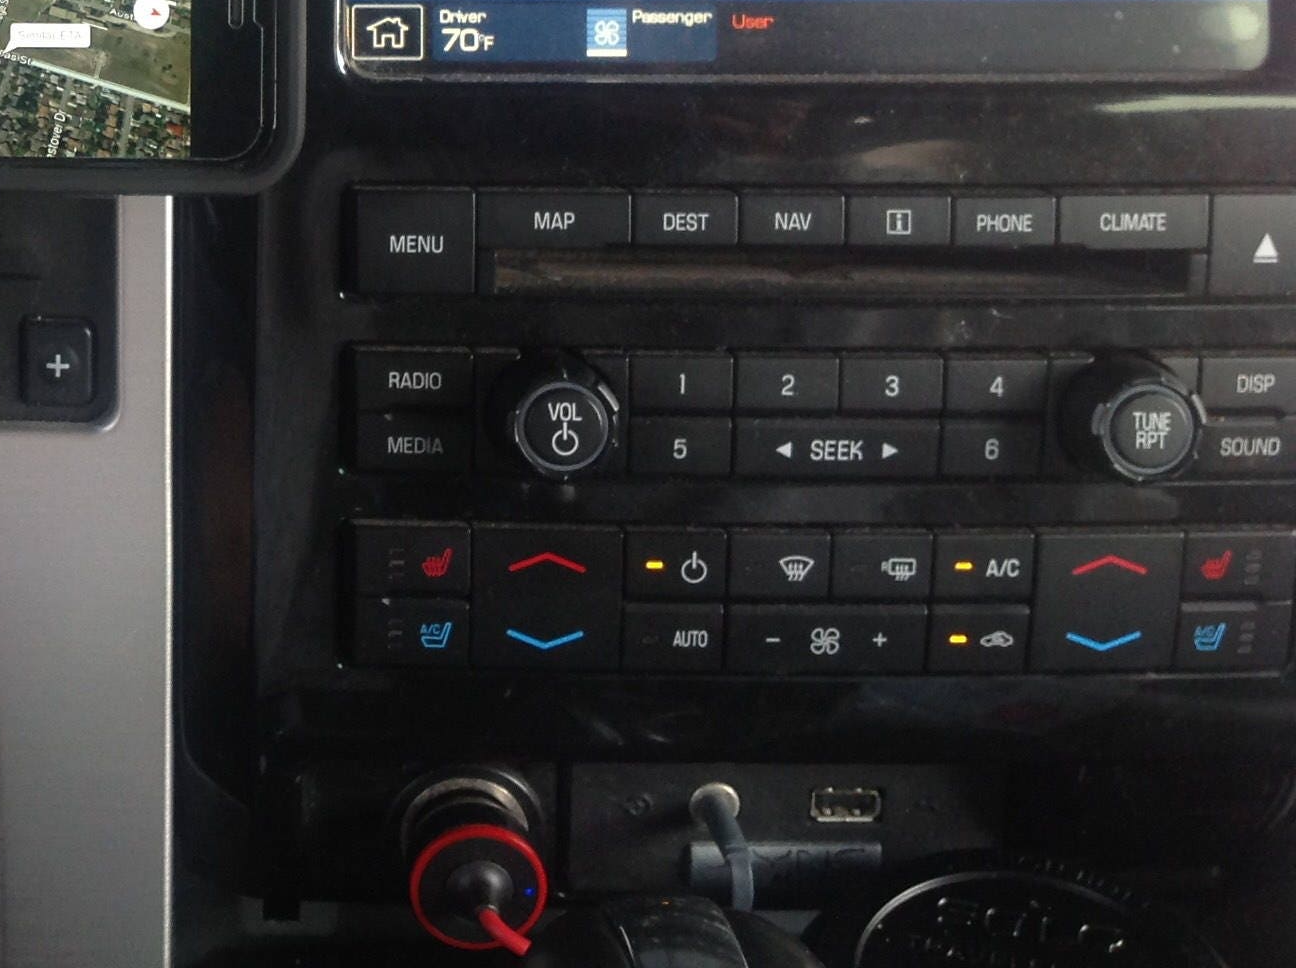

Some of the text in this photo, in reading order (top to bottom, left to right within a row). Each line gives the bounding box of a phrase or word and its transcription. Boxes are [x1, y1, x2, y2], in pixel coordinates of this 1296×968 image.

[439, 10, 487, 25] Driver
[632, 10, 713, 27] Passenger
[731, 14, 775, 30] User
[533, 212, 575, 230] MAP
[663, 213, 709, 232] DEST
[774, 213, 812, 231] NAV
[976, 214, 1033, 232] PHONE
[1100, 213, 1167, 231] CLIMATE
[389, 235, 444, 255] MENU
[388, 373, 442, 390] RADIO
[679, 375, 686, 395] 1
[781, 375, 795, 396] 2
[885, 376, 900, 396] 3
[989, 377, 1004, 397] 4
[1236, 375, 1275, 394] DISP
[548, 403, 582, 422] VOL
[1133, 412, 1171, 431] TUNE
[387, 437, 444, 454] MEDIA
[673, 439, 687, 460] 5
[984, 439, 999, 460] 6
[1135, 431, 1166, 450] RPT
[1220, 438, 1281, 457] SOUND
[810, 441, 864, 461] SEEK
[985, 559, 1020, 578] A/C
[673, 631, 708, 648] AUTO
